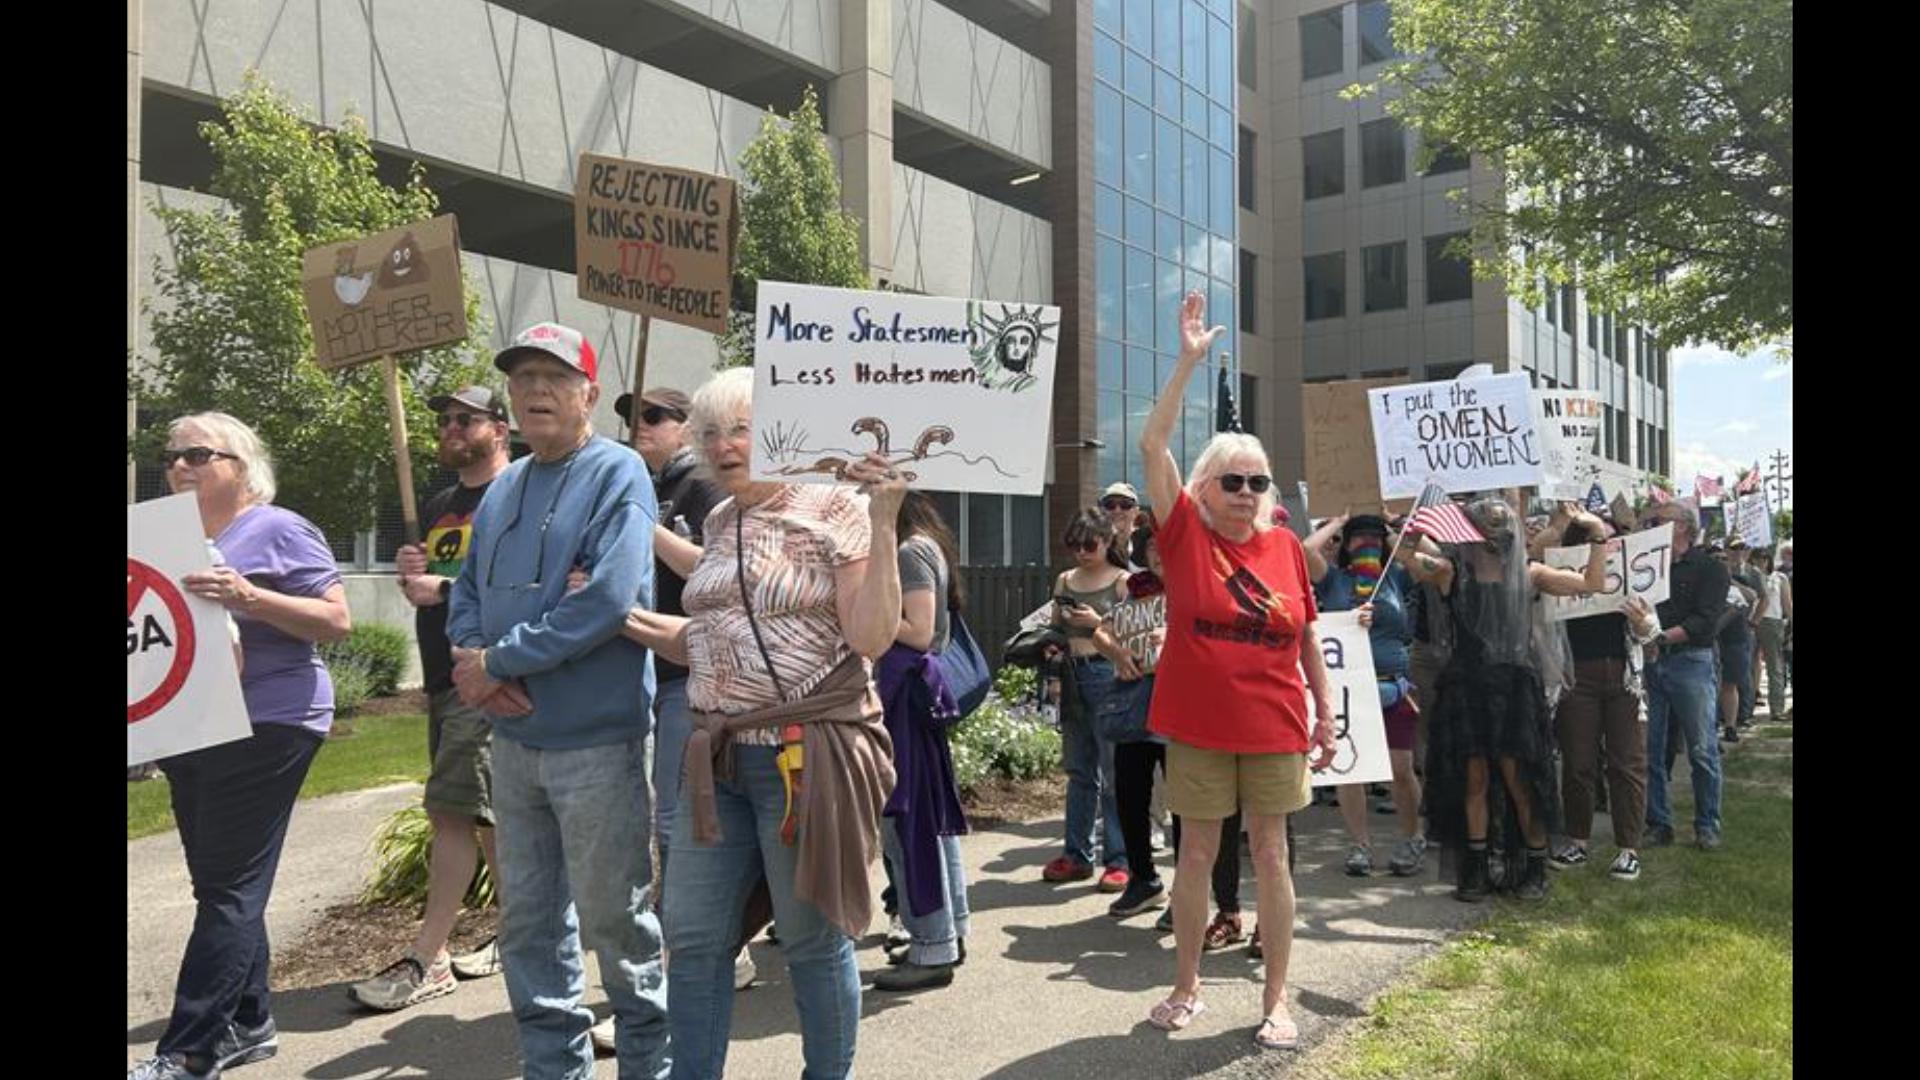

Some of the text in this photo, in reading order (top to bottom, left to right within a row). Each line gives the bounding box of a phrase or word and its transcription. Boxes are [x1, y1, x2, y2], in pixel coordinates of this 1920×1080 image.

[590, 163, 719, 217] REJECTING
[587, 206, 719, 252] KINGS SINCE
[618, 242, 676, 286] 1776
[587, 265, 625, 299] POWER
[626, 279, 645, 299] TO
[668, 287, 723, 318] PEOPLE
[323, 294, 431, 337] MOTHER
[767, 303, 978, 345] More Statesmen
[770, 363, 836, 387] Less
[1382, 383, 1478, 420] I put the
[1542, 398, 1562, 418] NO
[1417, 404, 1519, 443] OMEN
